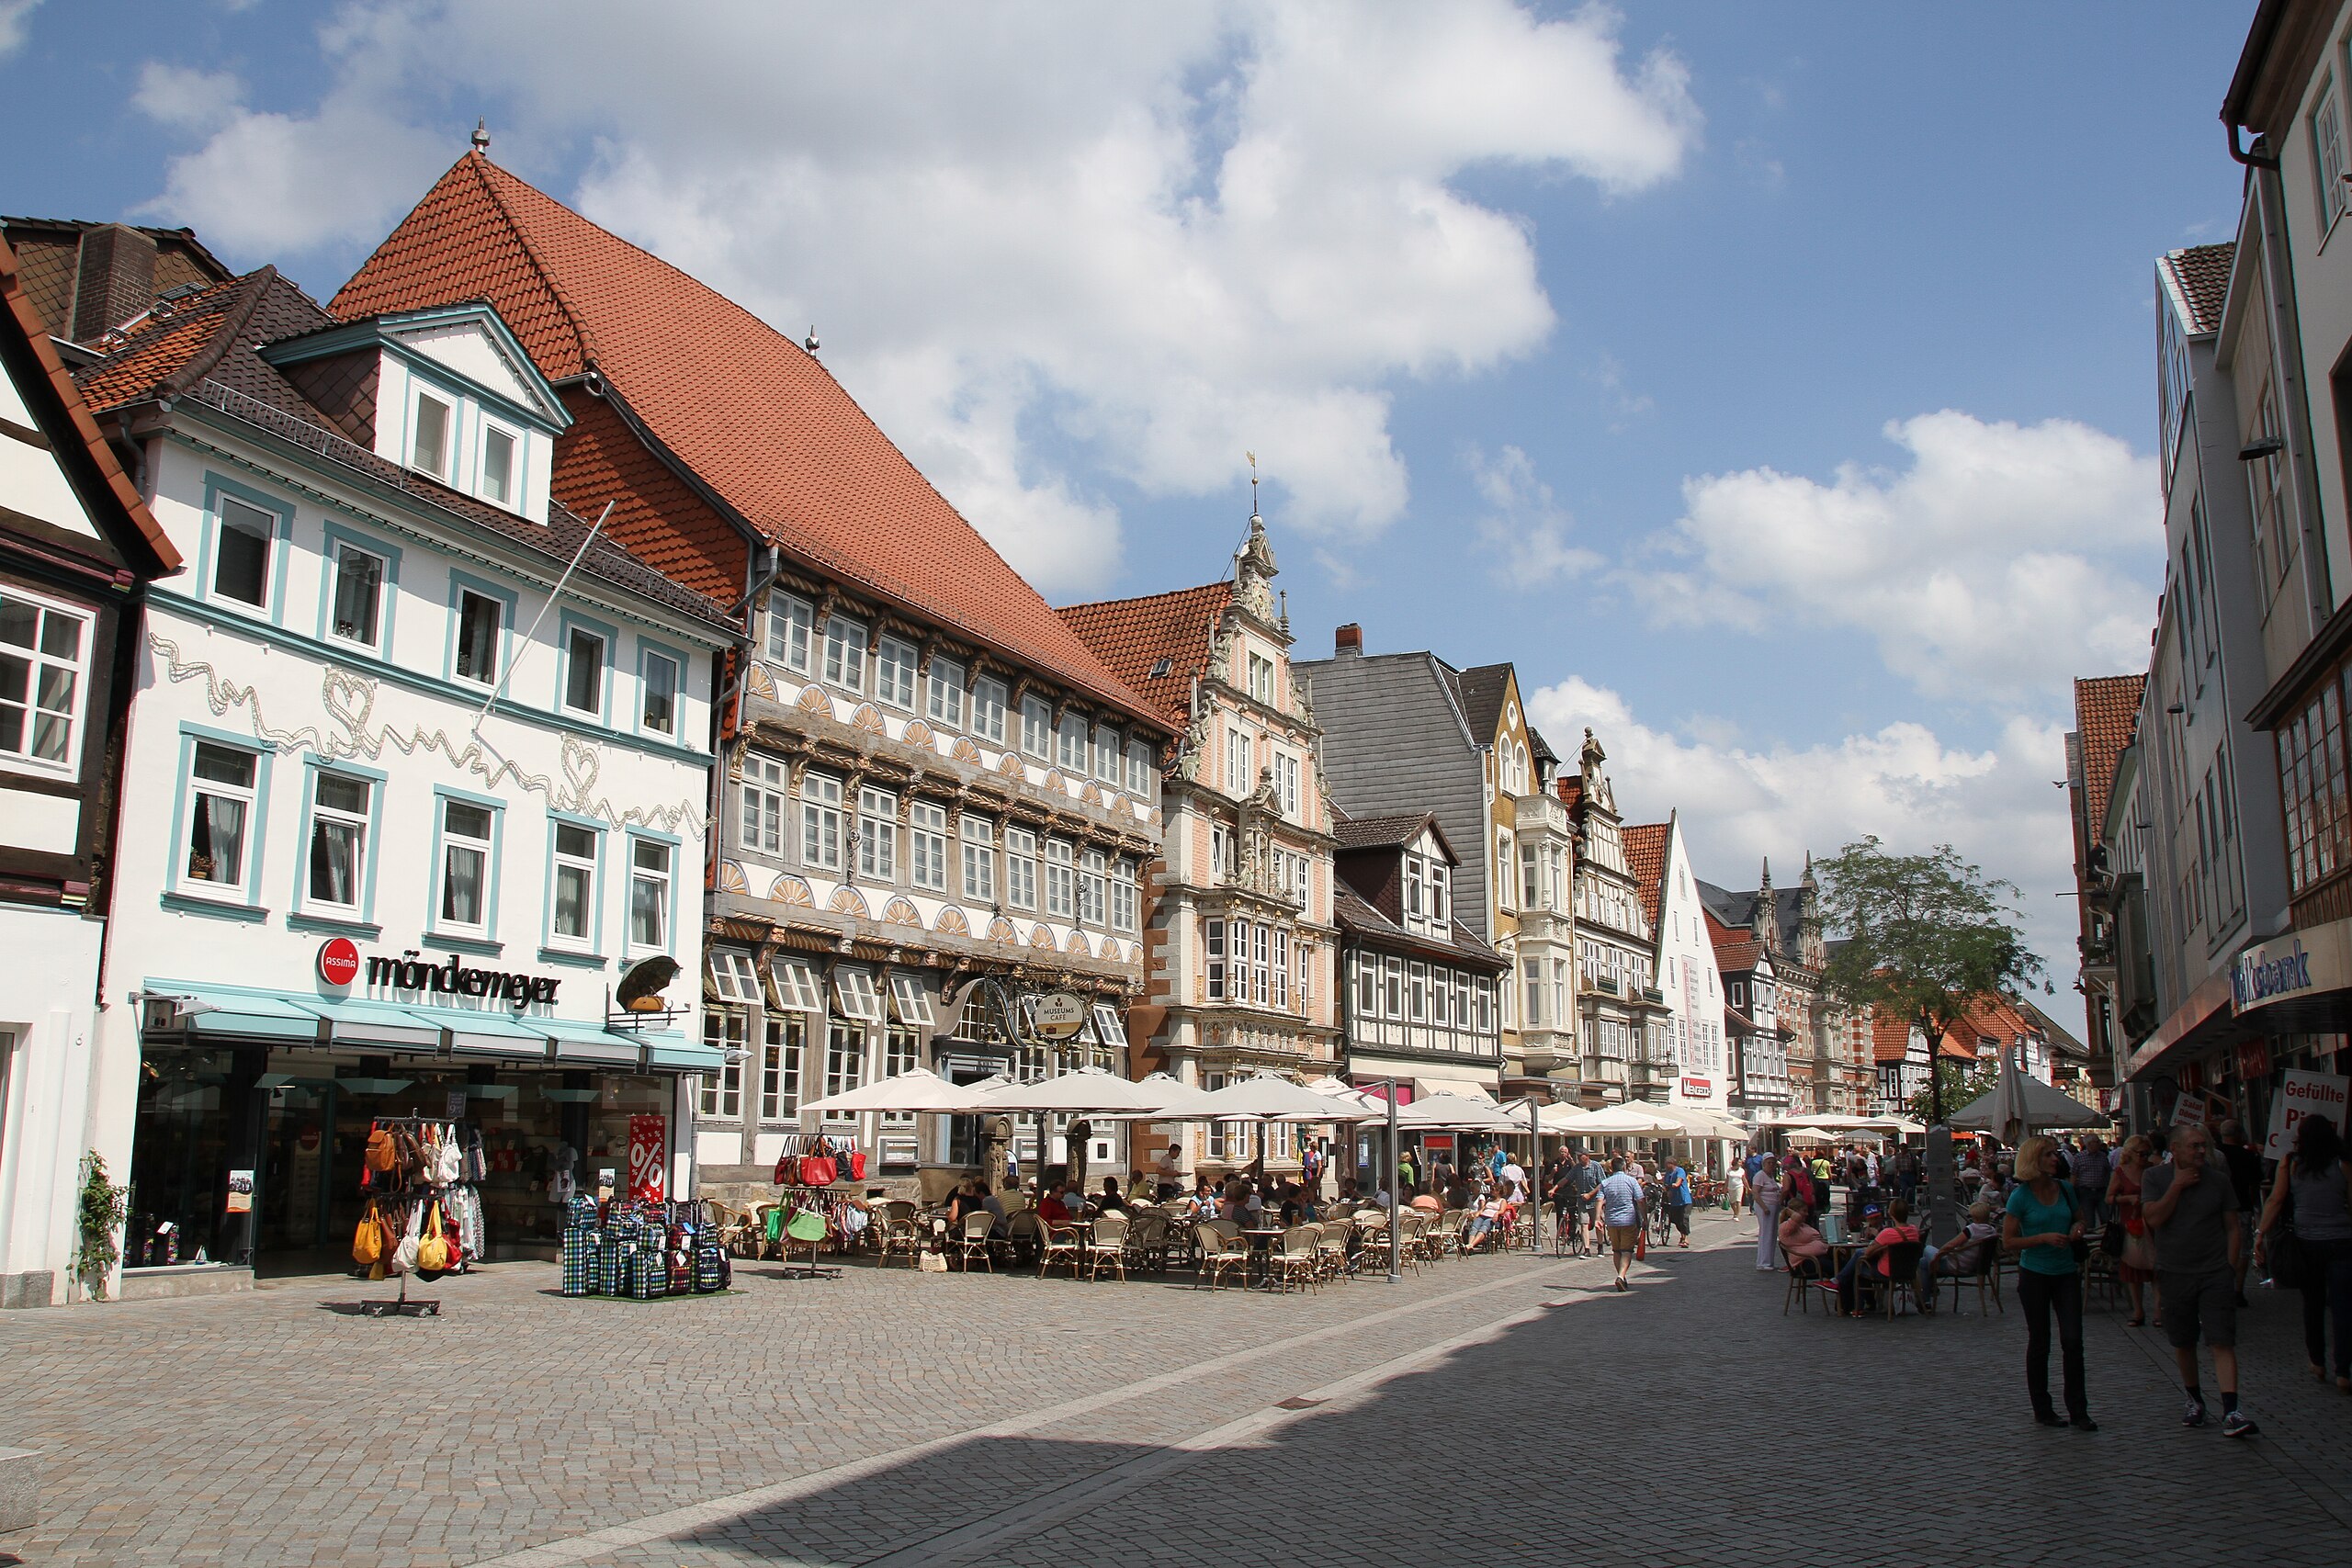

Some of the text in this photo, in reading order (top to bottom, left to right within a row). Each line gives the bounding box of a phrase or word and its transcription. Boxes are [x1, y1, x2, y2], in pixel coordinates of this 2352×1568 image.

[325, 956, 356, 969] ASSIMA
[368, 949, 561, 1010] mönckemeyer
[1043, 1007, 1075, 1015] MUSEUMS
[2285, 1080, 2344, 1103] Gefüllte
